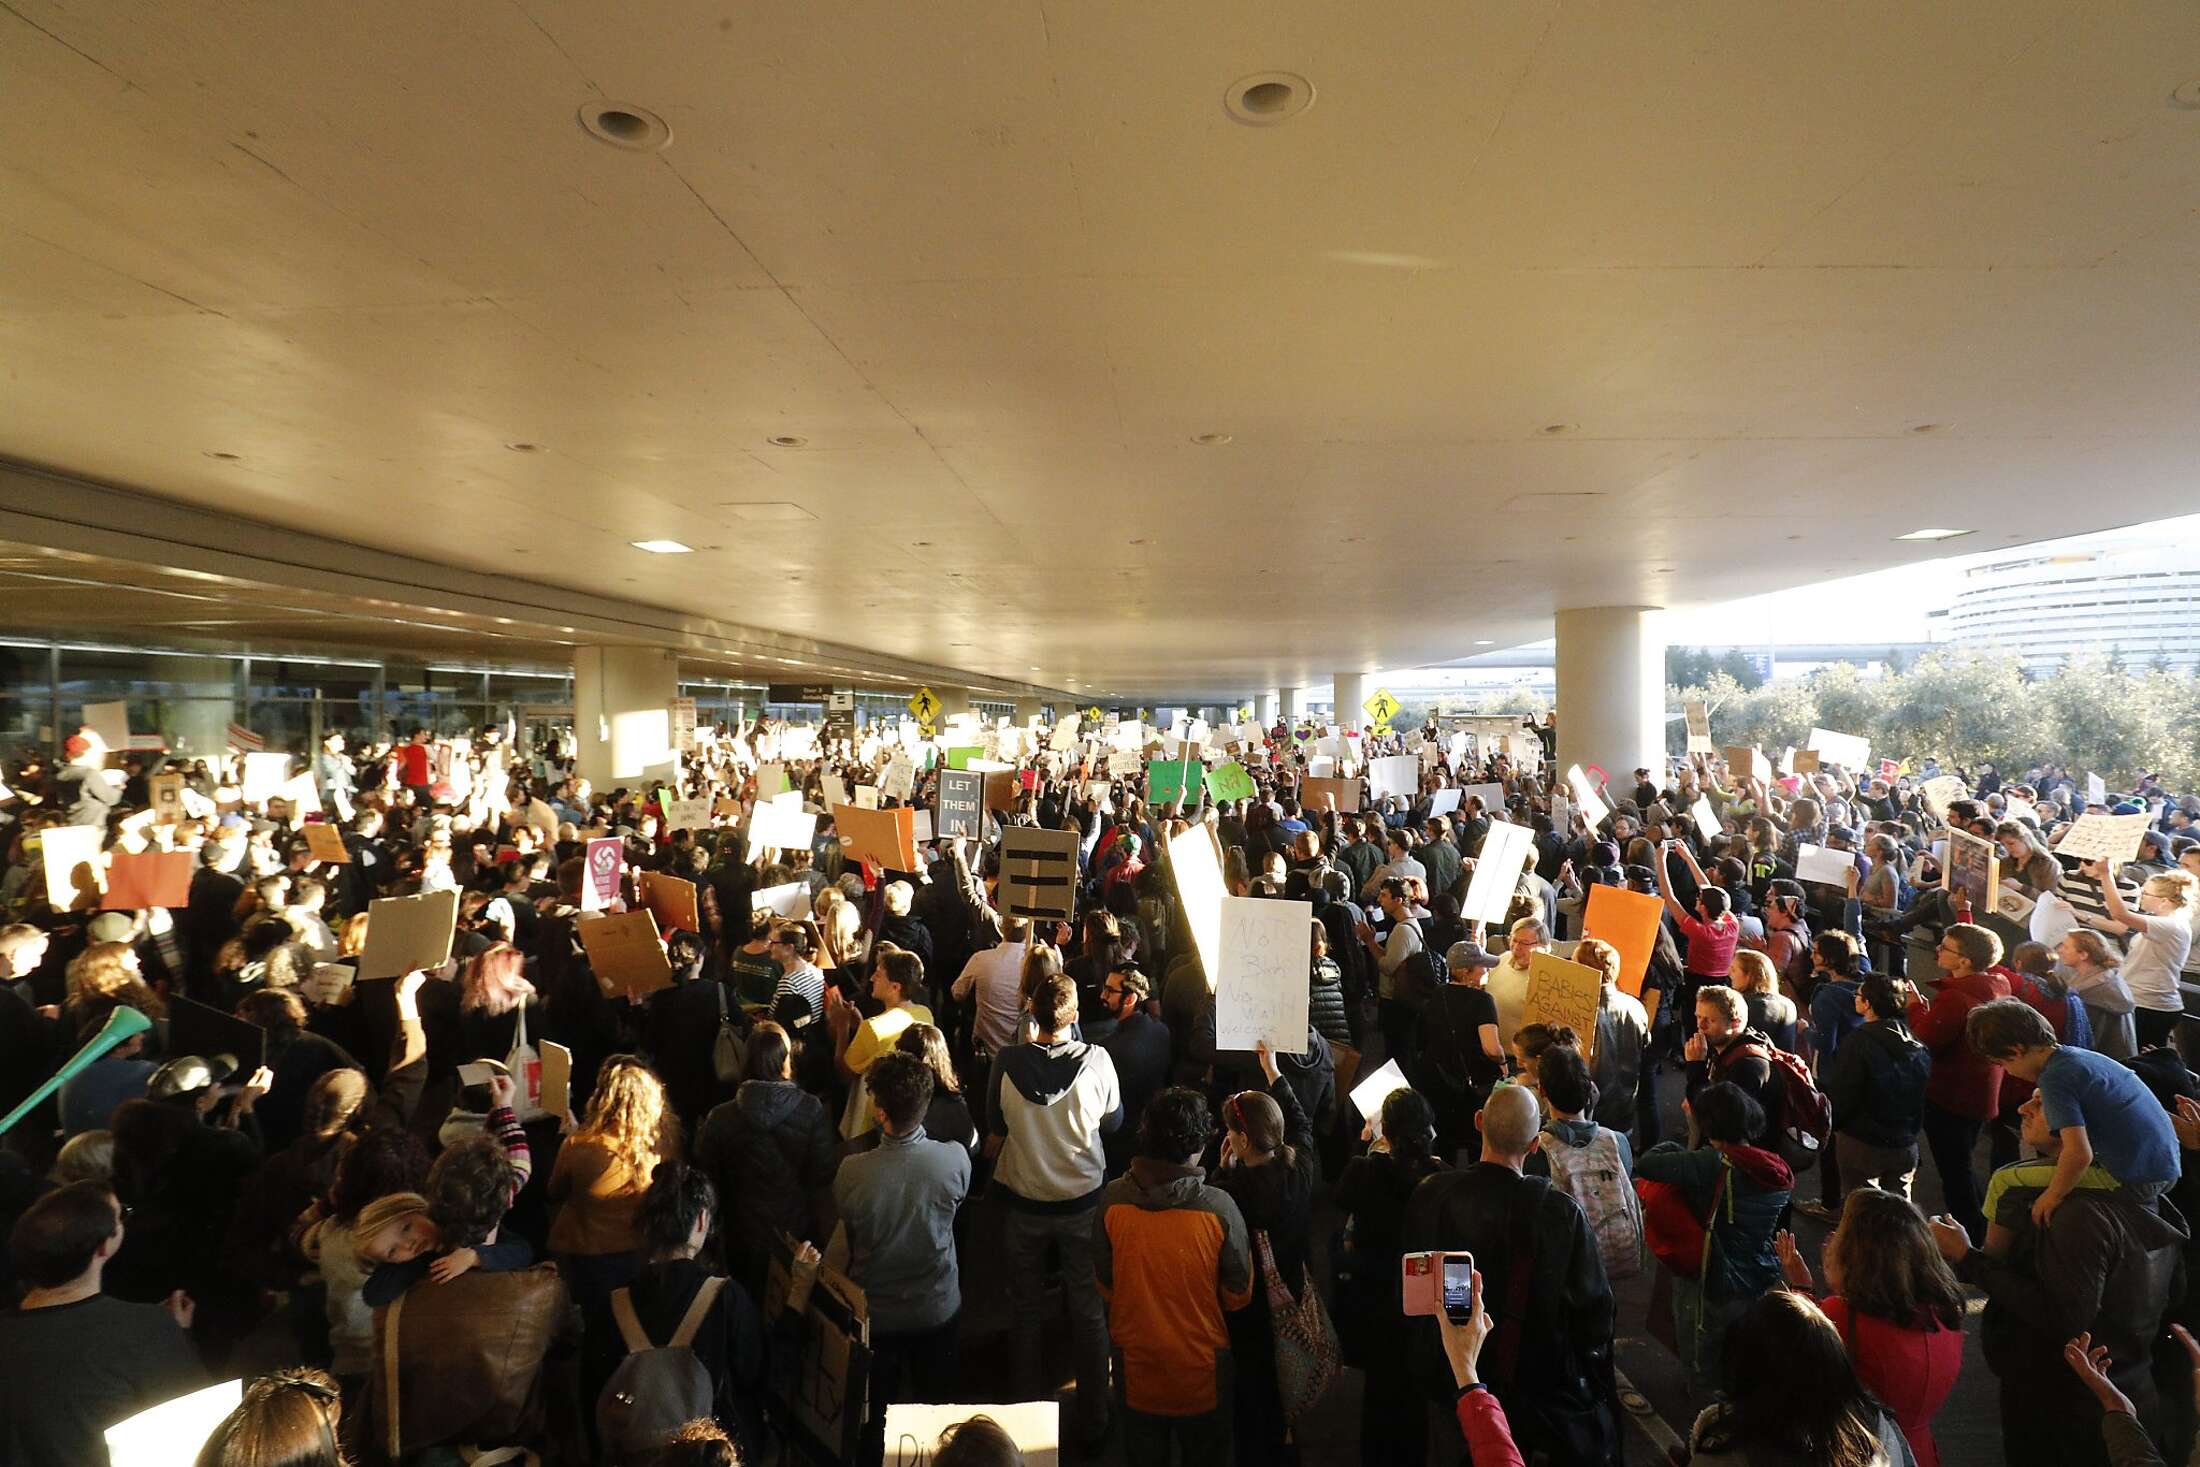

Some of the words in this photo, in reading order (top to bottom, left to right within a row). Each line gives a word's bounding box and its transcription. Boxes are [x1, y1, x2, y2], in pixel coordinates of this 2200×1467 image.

[948, 780, 972, 791] LET
[943, 799, 975, 812] THEM
[950, 819, 966, 833] IN
[1536, 969, 1594, 1013] BABIES
[1527, 991, 1593, 1031] AGAINST
